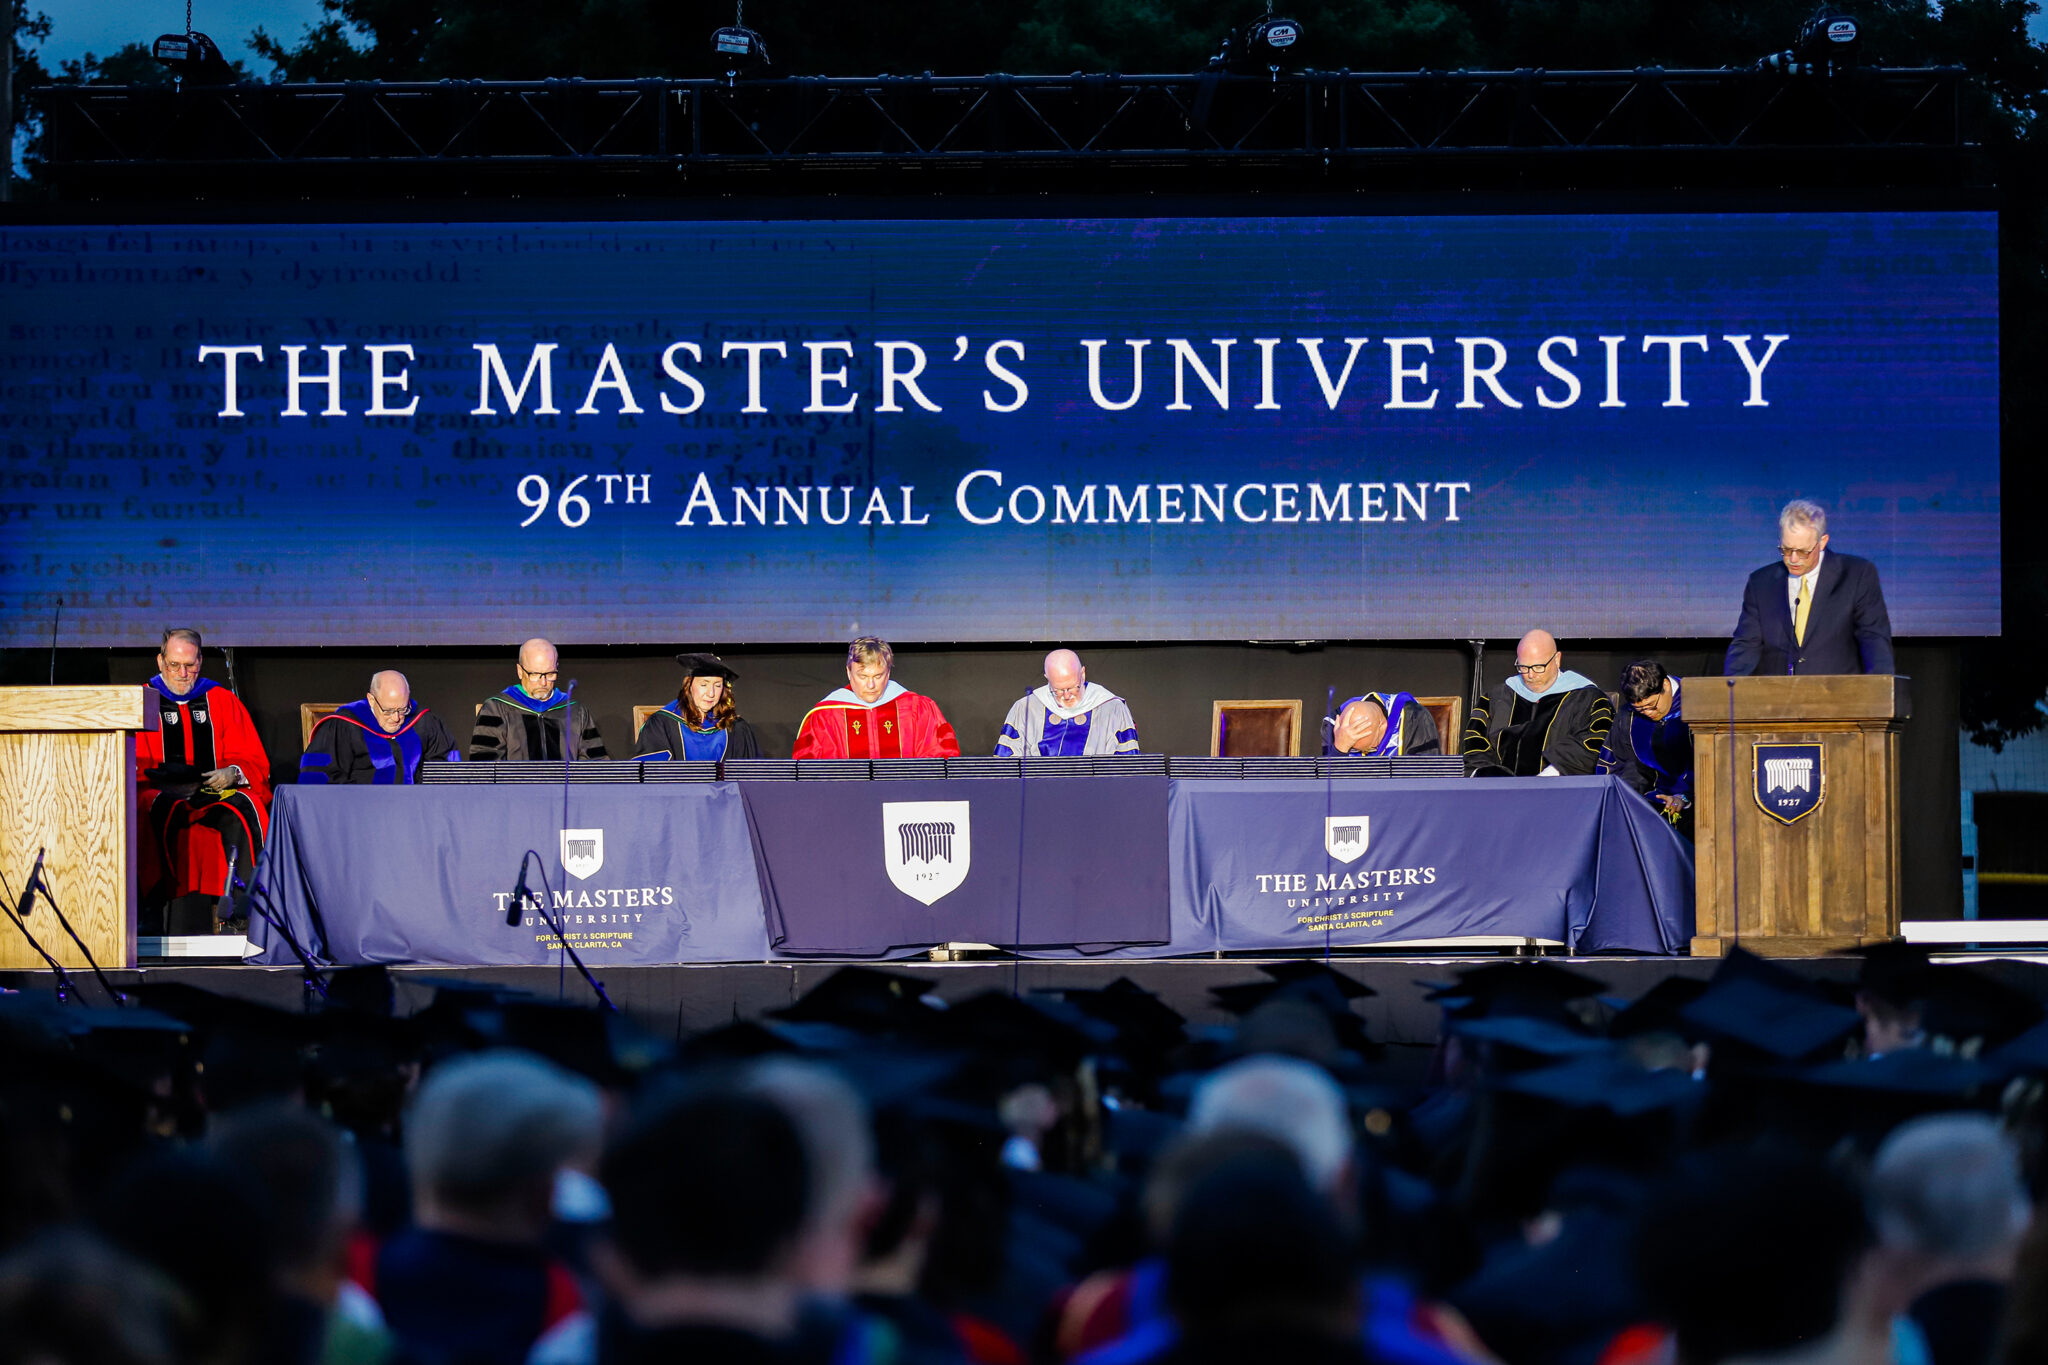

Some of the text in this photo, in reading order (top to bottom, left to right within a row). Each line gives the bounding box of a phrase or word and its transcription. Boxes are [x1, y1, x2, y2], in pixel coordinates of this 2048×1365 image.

[199, 344, 419, 416] THE
[471, 336, 1028, 415] MASTER'S
[1080, 335, 1789, 410] UNIVERSITY
[517, 475, 651, 527] 96TH
[675, 472, 930, 526] ANNUAL
[956, 470, 1471, 525] COMMENCEMENT
[1778, 799, 1800, 807] 1927
[1256, 867, 1436, 893] THE MASTER'S
[552, 886, 673, 909] MASTER'S
[1287, 891, 1405, 908] UNIVERSITY
[525, 913, 643, 926] UNIVERSITY
[1297, 916, 1313, 924] FOR
[1314, 913, 1342, 923] CHRIST
[1351, 909, 1394, 919] SCRIPTURE
[1308, 919, 1383, 932] SANTA CLARITA, CA
[535, 934, 551, 942] FOR
[552, 933, 581, 941] CRIST
[590, 932, 633, 940] SCRIPTURE
[547, 942, 573, 950] SANA
[574, 941, 610, 949] CLARITA,
